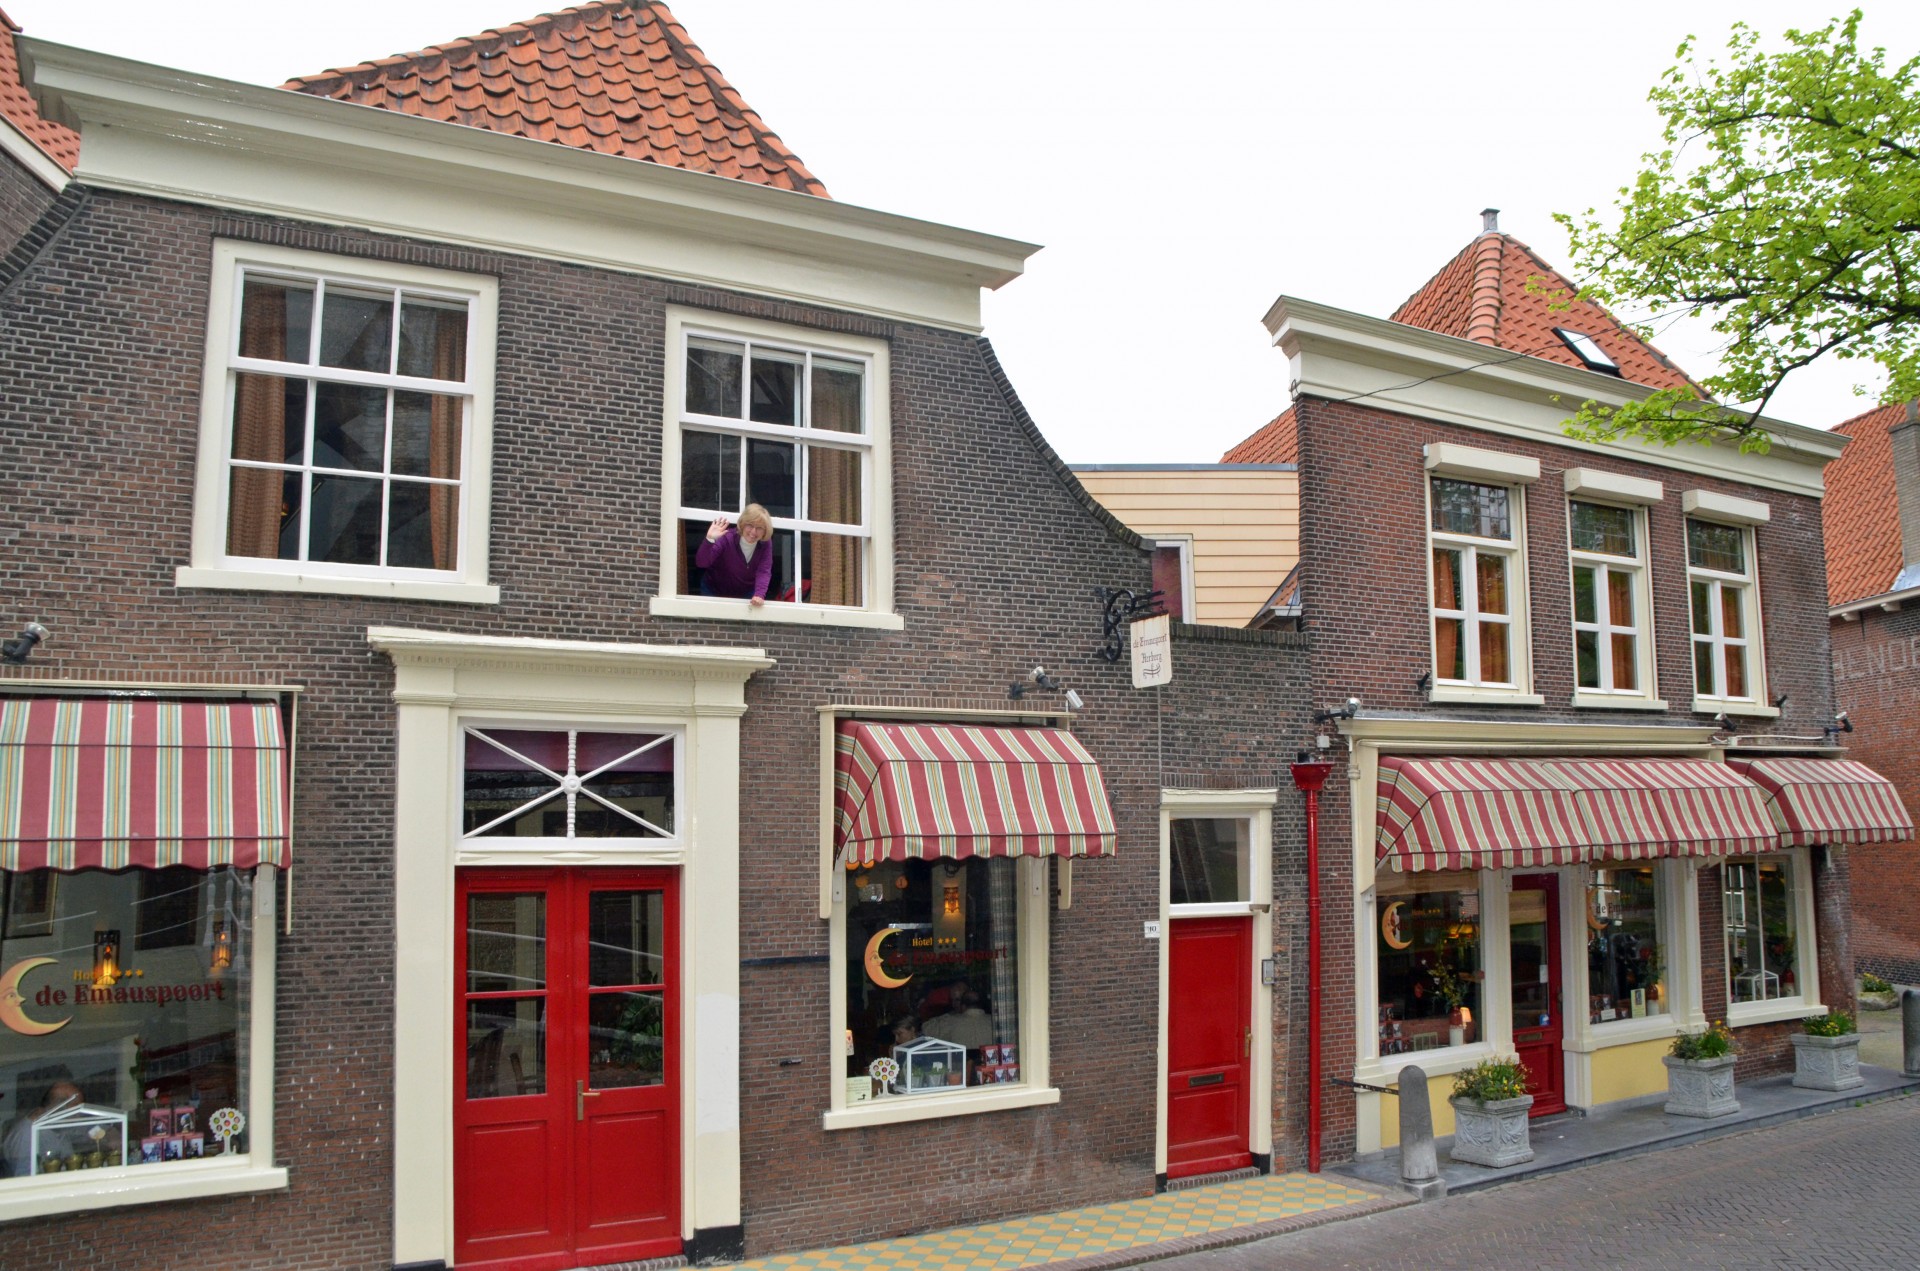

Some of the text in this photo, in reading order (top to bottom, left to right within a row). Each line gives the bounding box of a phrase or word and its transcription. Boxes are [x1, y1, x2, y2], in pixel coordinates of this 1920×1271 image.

[912, 937, 933, 947] Hotel
[35, 979, 226, 1007] de Emauspoort
